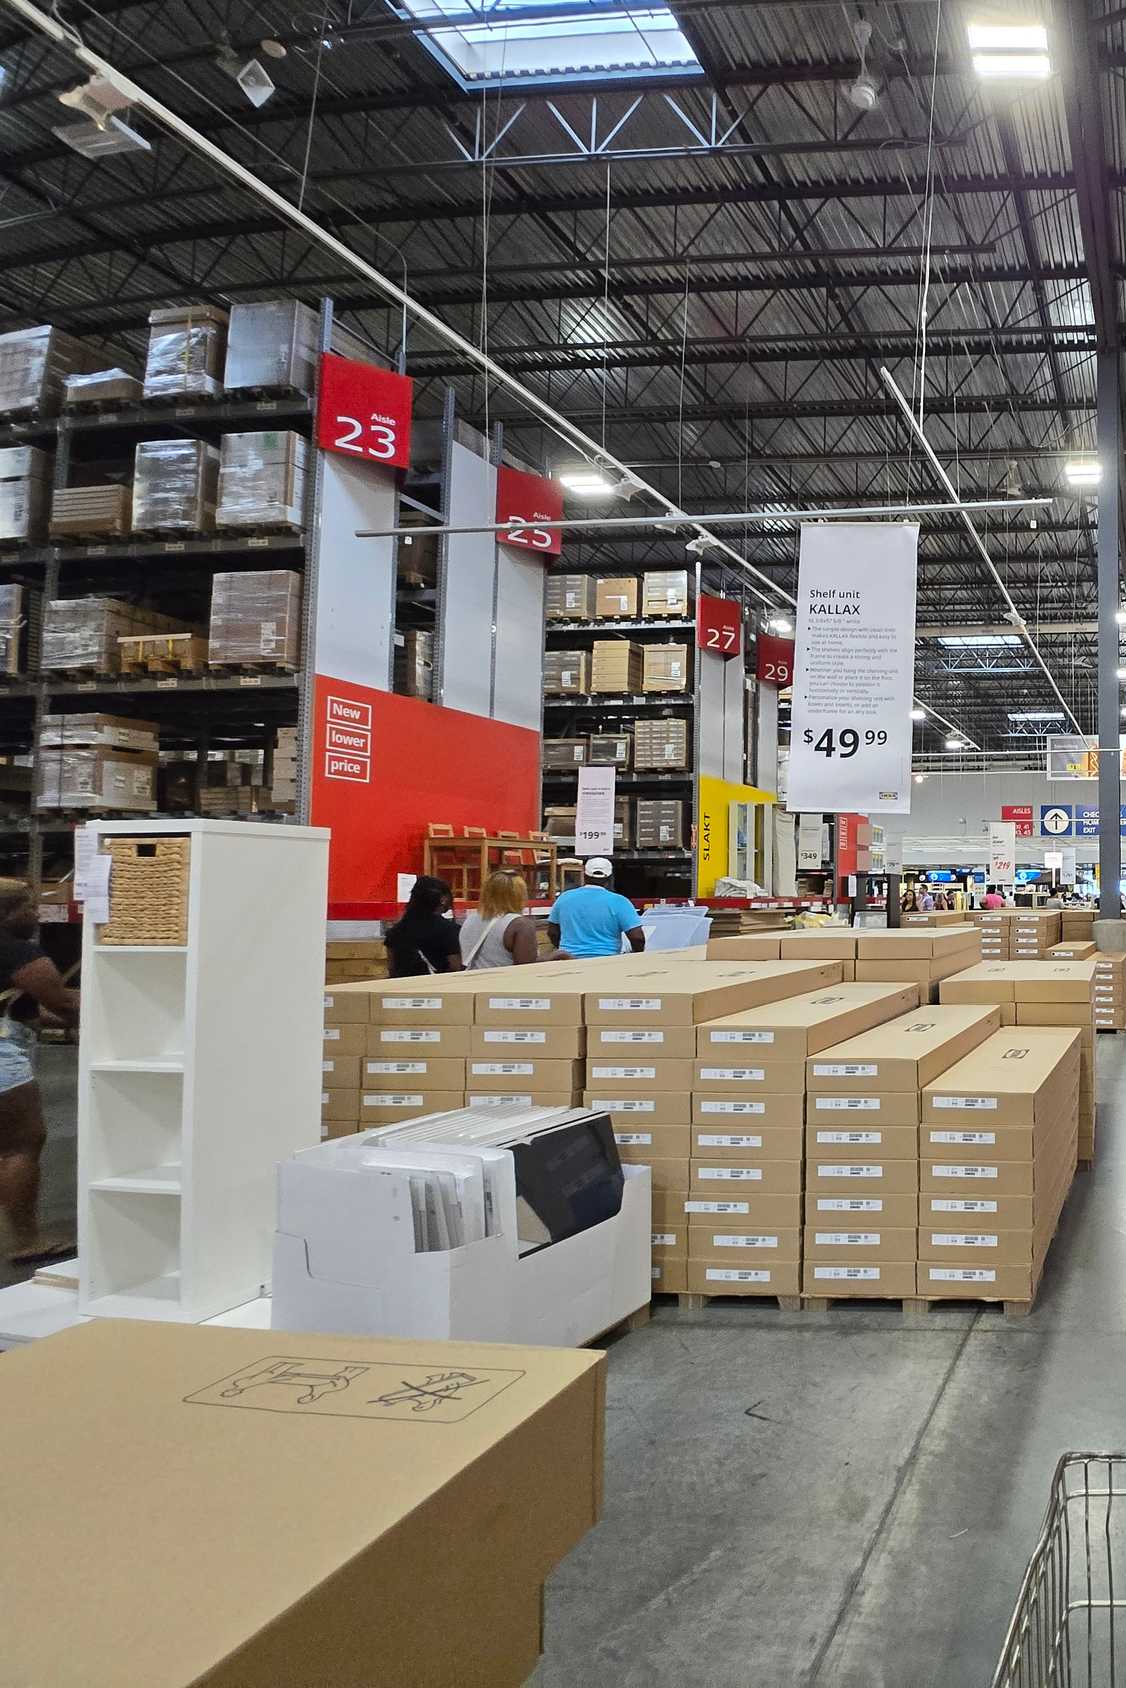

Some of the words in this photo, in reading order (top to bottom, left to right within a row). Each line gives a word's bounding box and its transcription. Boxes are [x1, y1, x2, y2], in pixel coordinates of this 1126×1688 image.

[370, 413, 396, 426] Aisle
[334, 416, 396, 459] 23
[533, 511, 551, 521] Aisle
[507, 515, 552, 548] 25
[809, 589, 836, 599] Shelf
[838, 589, 861, 599] unit
[809, 604, 860, 615] KALLAX
[706, 628, 736, 650] 27
[764, 663, 789, 682] 29
[332, 703, 361, 720] New
[331, 730, 366, 748] lower
[330, 759, 361, 774] price
[703, 811, 711, 862] SLAKT
